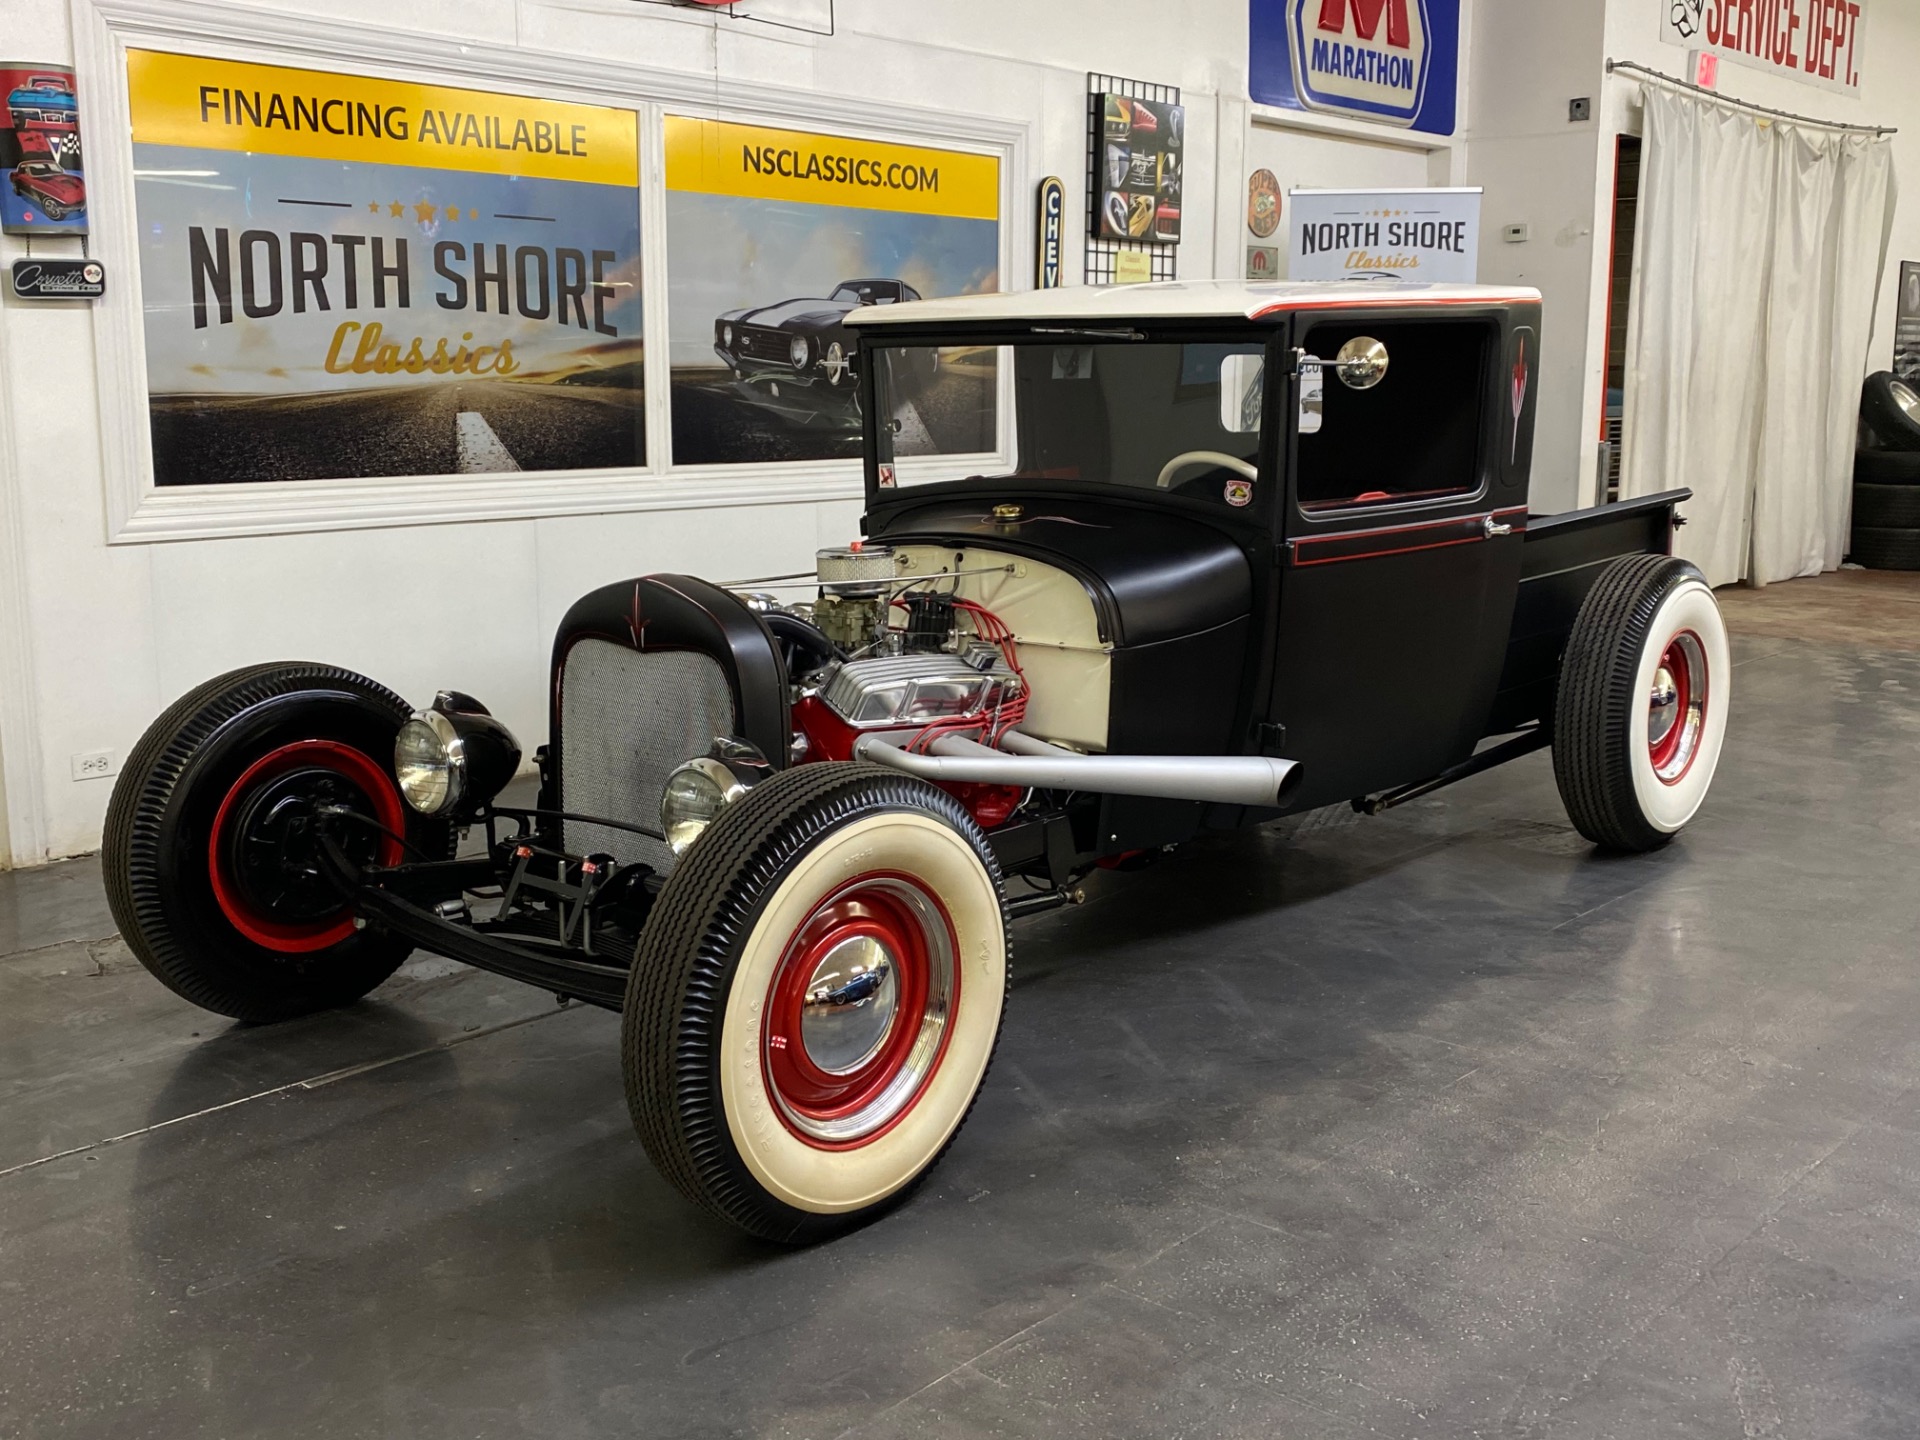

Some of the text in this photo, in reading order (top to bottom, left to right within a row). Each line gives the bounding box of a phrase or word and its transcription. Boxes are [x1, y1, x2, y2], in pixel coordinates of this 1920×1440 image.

[1311, 38, 1413, 90] MARATHON
[1706, 0, 1860, 87] SERVICE DEPT.
[199, 86, 588, 157] FINANCING AVAILABLE
[743, 145, 939, 193] NSCLASSICS.COM
[1301, 221, 1467, 256] NORTH SHORE
[1344, 251, 1420, 269] Classics
[14, 265, 86, 291] Corvette
[188, 226, 619, 338] NORTH SHORE
[325, 321, 521, 376] Classics
